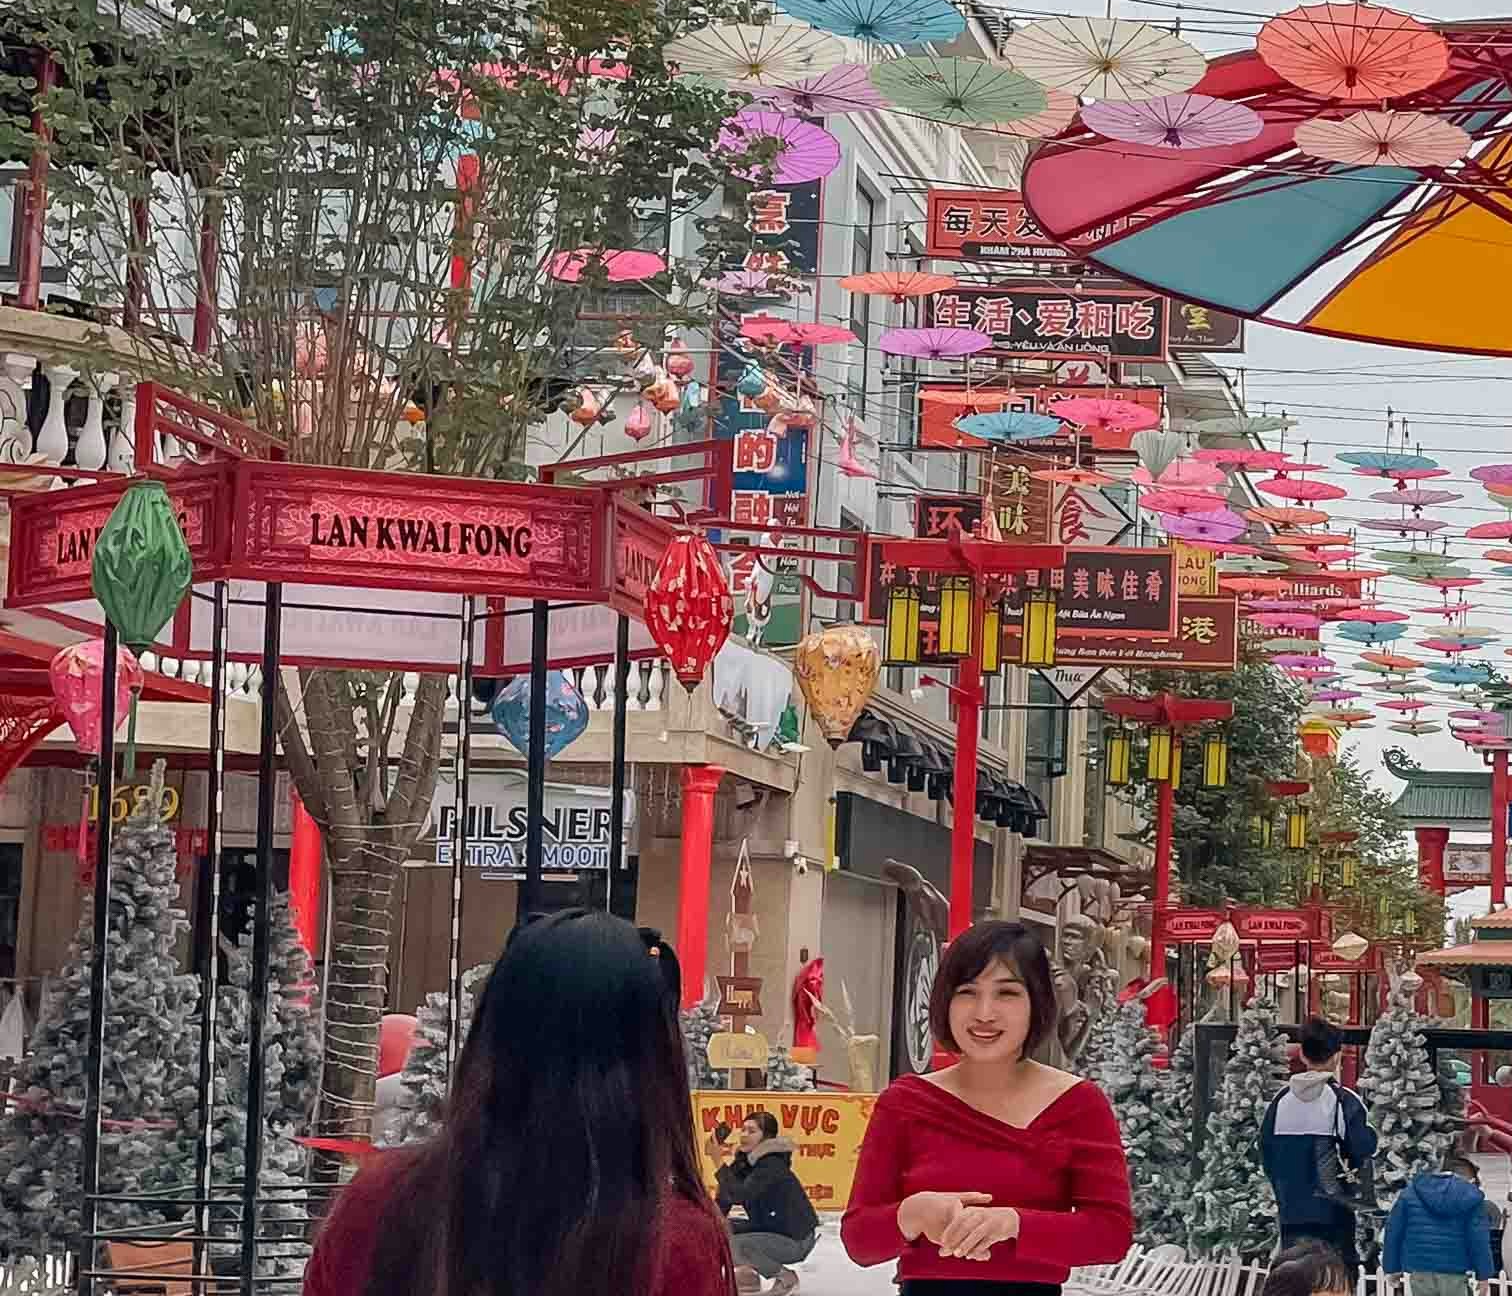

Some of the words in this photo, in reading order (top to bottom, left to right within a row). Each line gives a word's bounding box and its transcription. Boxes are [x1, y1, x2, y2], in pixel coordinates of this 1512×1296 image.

[310, 512, 369, 547] LAN
[375, 516, 452, 554] KWAI
[459, 522, 533, 558] FONG
[780, 1104, 841, 1137] VỰC
